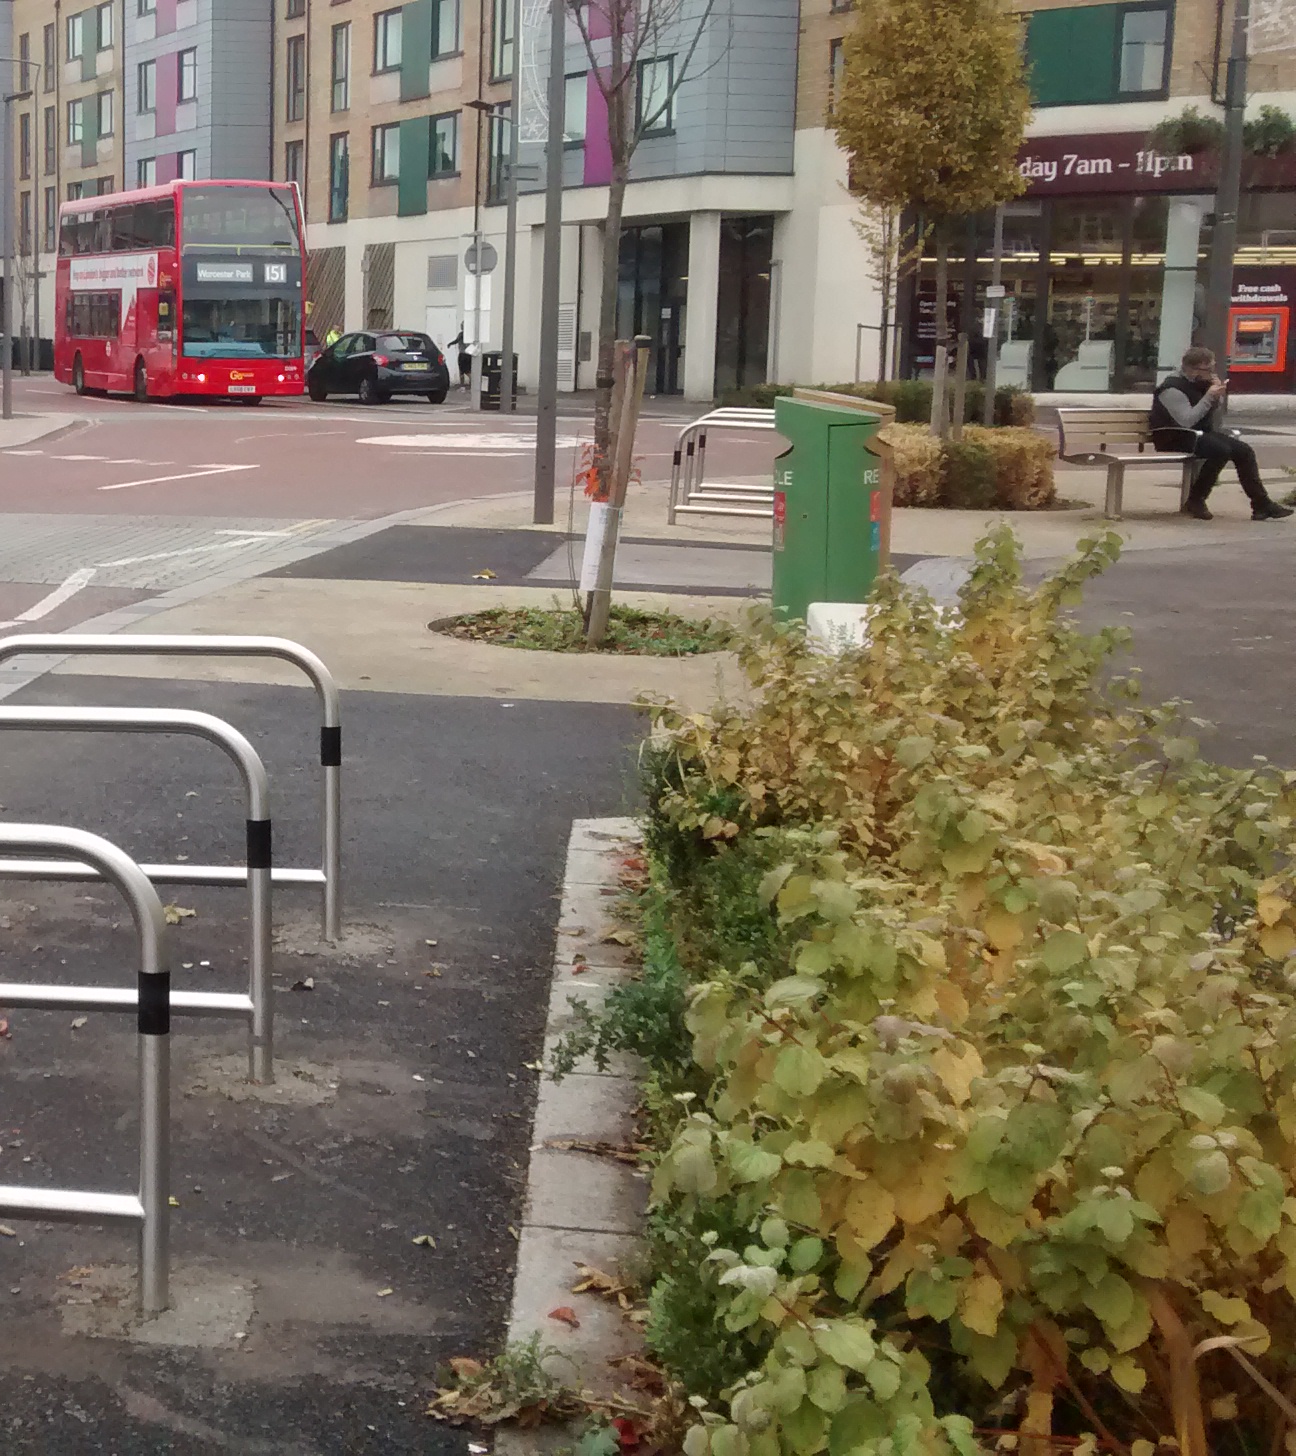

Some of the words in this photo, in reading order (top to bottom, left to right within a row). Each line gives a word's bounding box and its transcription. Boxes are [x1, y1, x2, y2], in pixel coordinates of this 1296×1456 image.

[1063, 154, 1113, 176] 7am
[197, 269, 234, 278] Worcester
[235, 269, 251, 278] Park
[265, 265, 285, 281] 151
[1237, 284, 1259, 293] Free
[1260, 283, 1282, 292] cash
[1231, 293, 1288, 302] withdrawals
